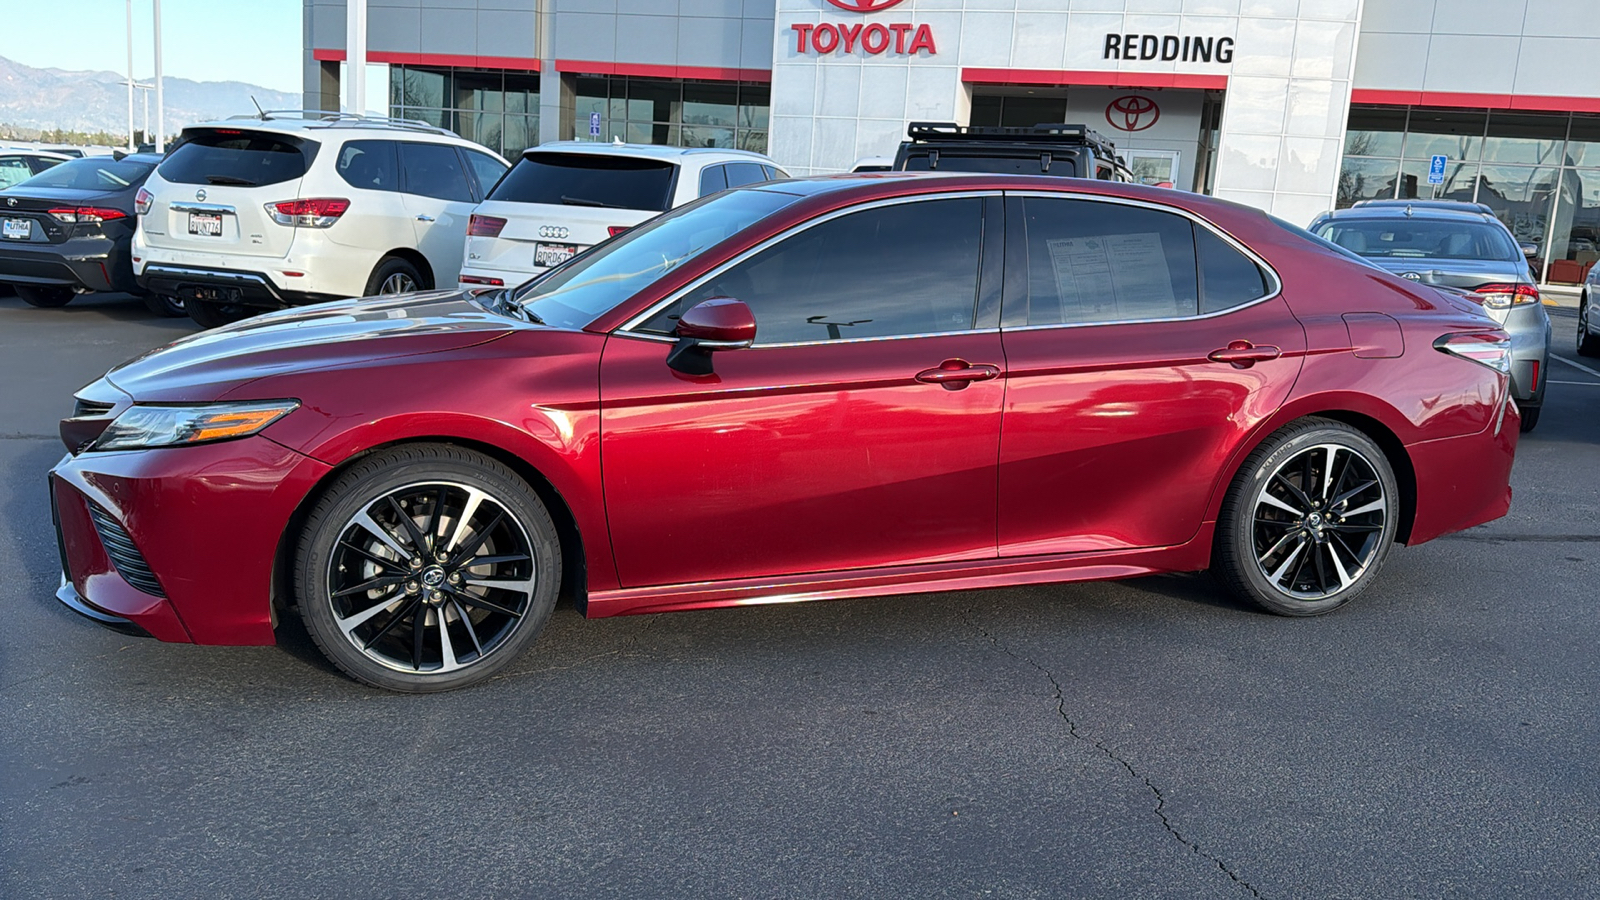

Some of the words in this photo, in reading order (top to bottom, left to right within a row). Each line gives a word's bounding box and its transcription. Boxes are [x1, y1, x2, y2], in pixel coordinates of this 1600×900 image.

[791, 23, 936, 54] TOYOTA
[1104, 33, 1234, 63] REDDING
[10, 222, 28, 231] LITHIA
[1263, 442, 1292, 471] KUMHO
[307, 551, 319, 601] KUMHO
